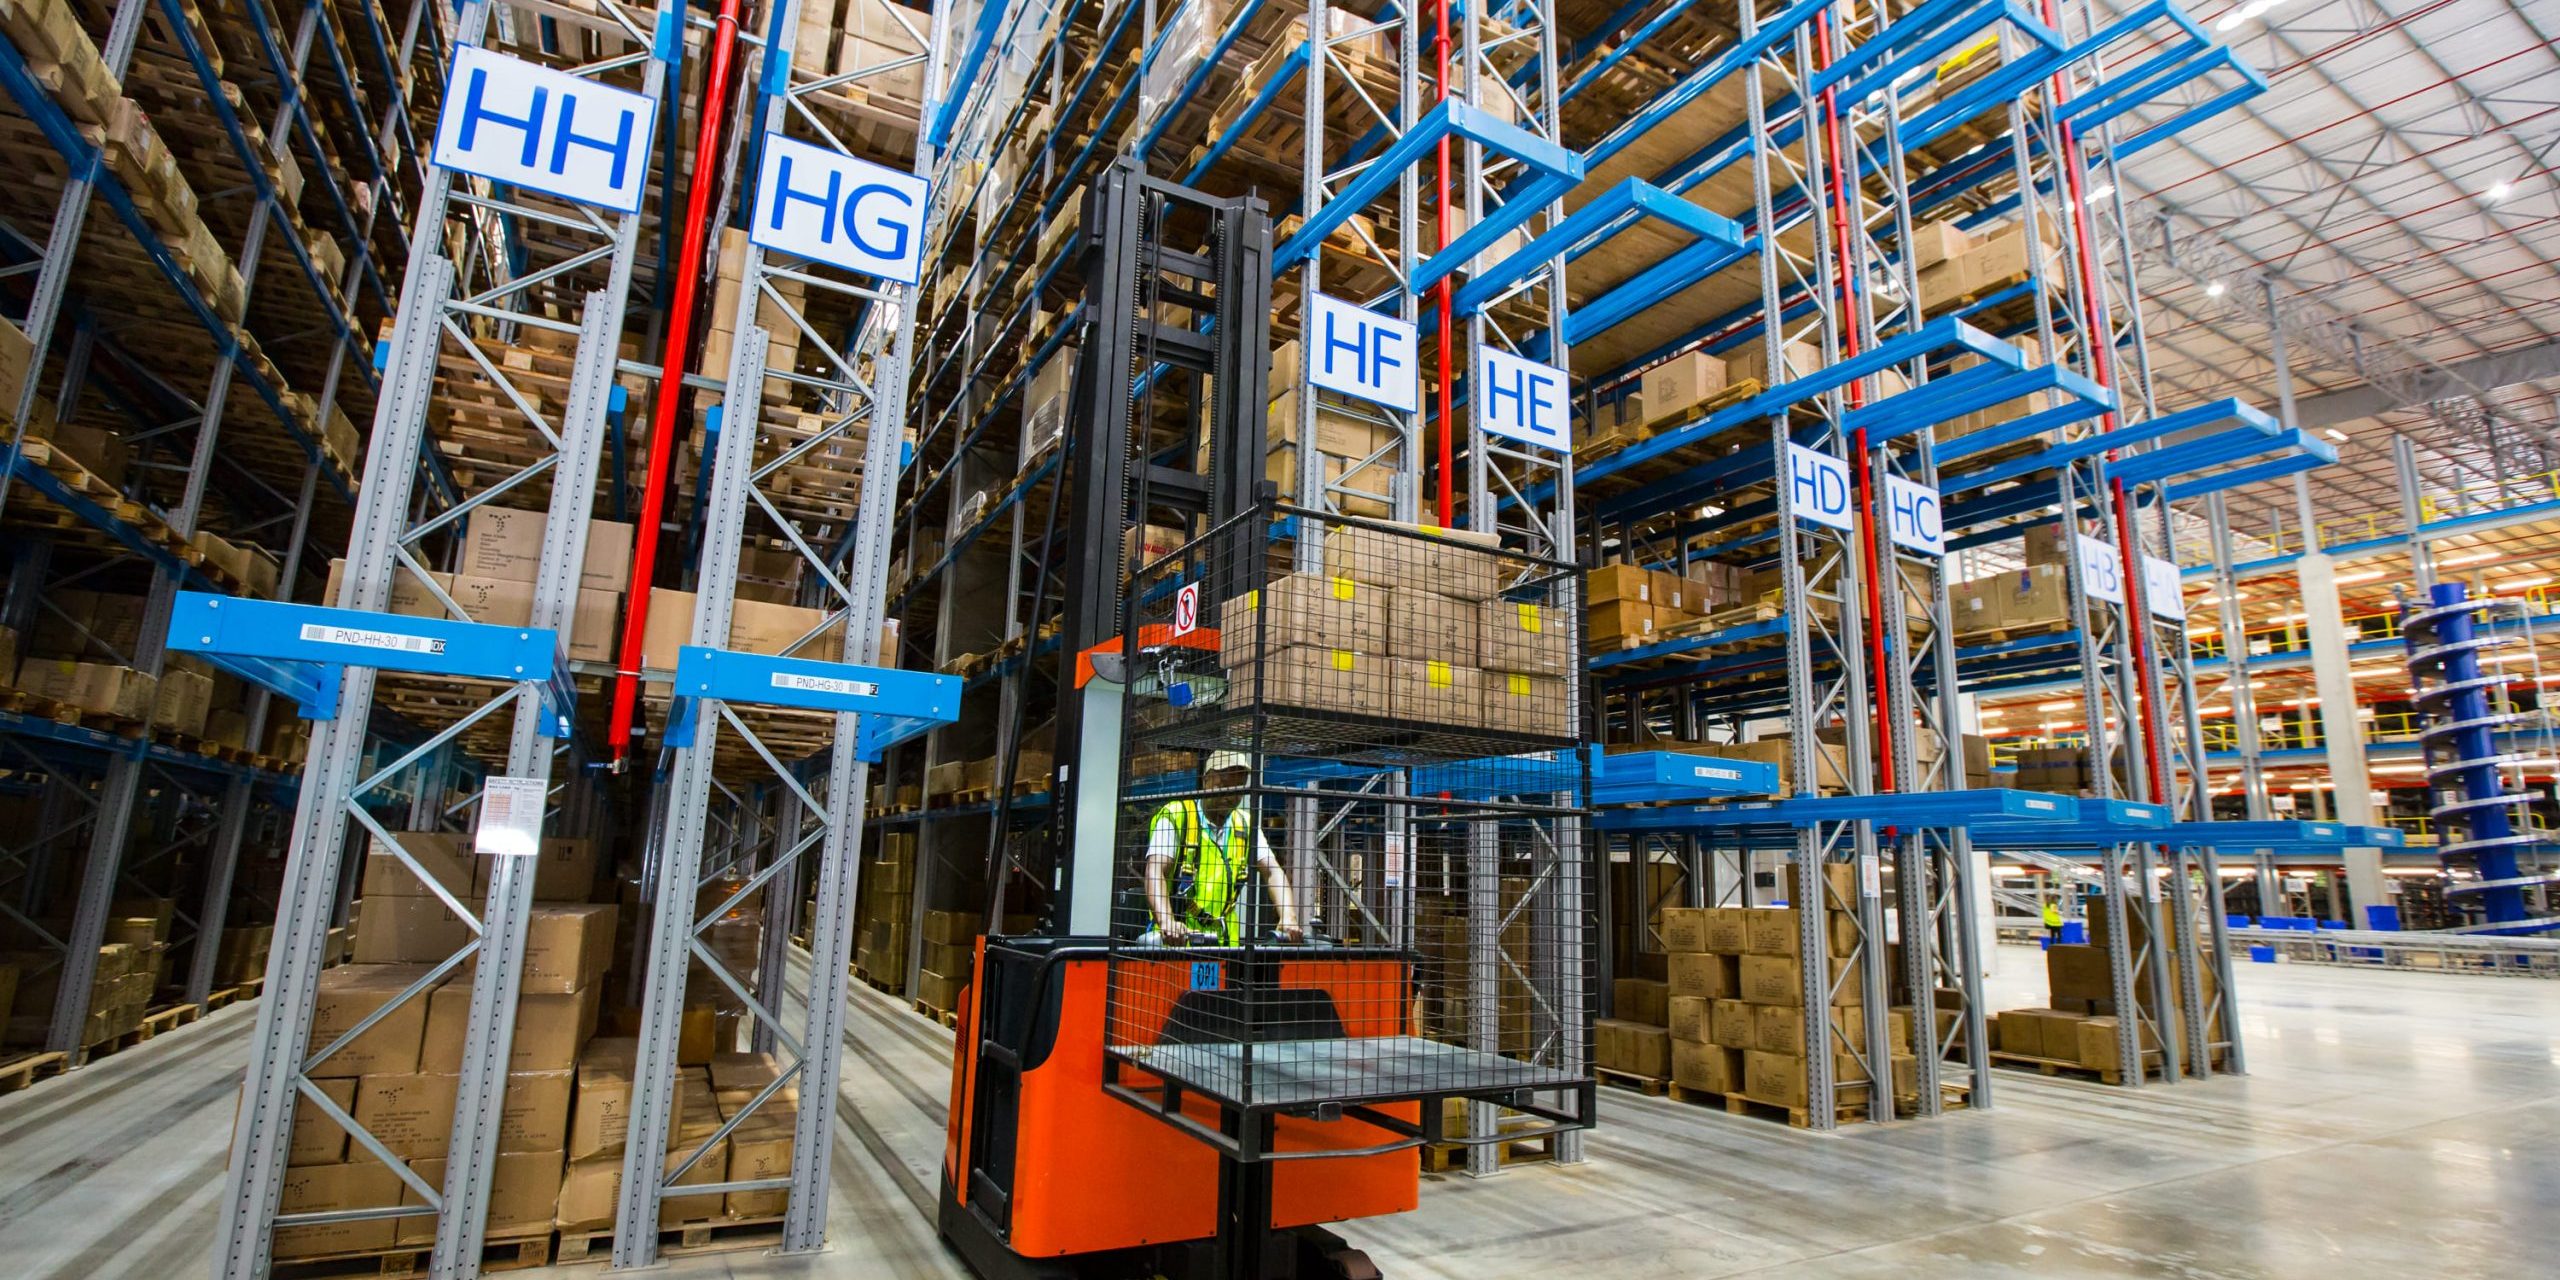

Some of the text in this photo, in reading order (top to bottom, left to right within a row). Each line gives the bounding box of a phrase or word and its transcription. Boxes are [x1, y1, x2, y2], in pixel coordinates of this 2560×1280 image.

[457, 67, 636, 191] HH
[769, 154, 913, 261] HG
[1323, 311, 1403, 389] HF
[1488, 360, 1557, 437] HE
[1791, 453, 1848, 516] HD
[1892, 488, 1938, 545] HC
[2083, 545, 2118, 593] HB
[335, 630, 398, 648] PND-HH-30
[796, 677, 844, 692] PND-HG-30
